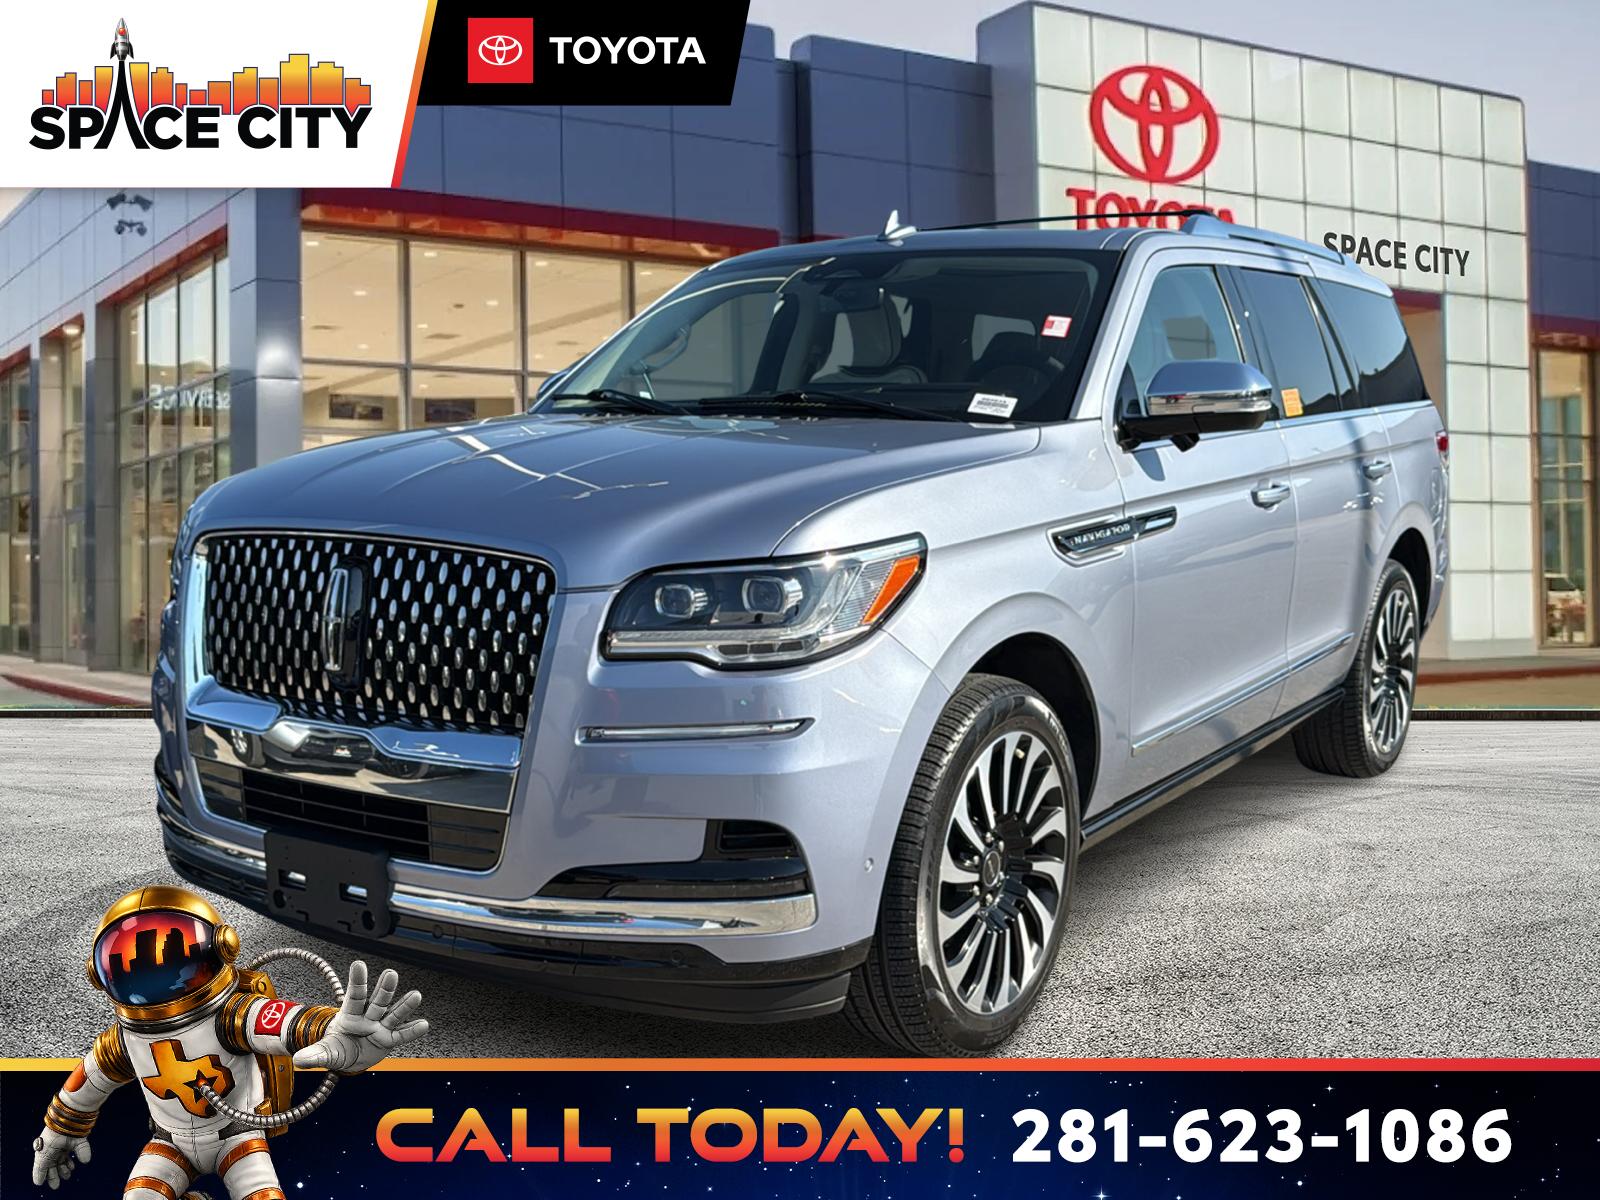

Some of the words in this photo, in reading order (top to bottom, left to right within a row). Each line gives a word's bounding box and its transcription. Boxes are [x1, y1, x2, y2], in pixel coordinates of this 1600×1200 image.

[1066, 188, 1234, 231] TOYO
[1323, 232, 1407, 270] SPACE
[1414, 244, 1470, 277] CITY
[1074, 524, 1131, 545] NAVIGATOR
